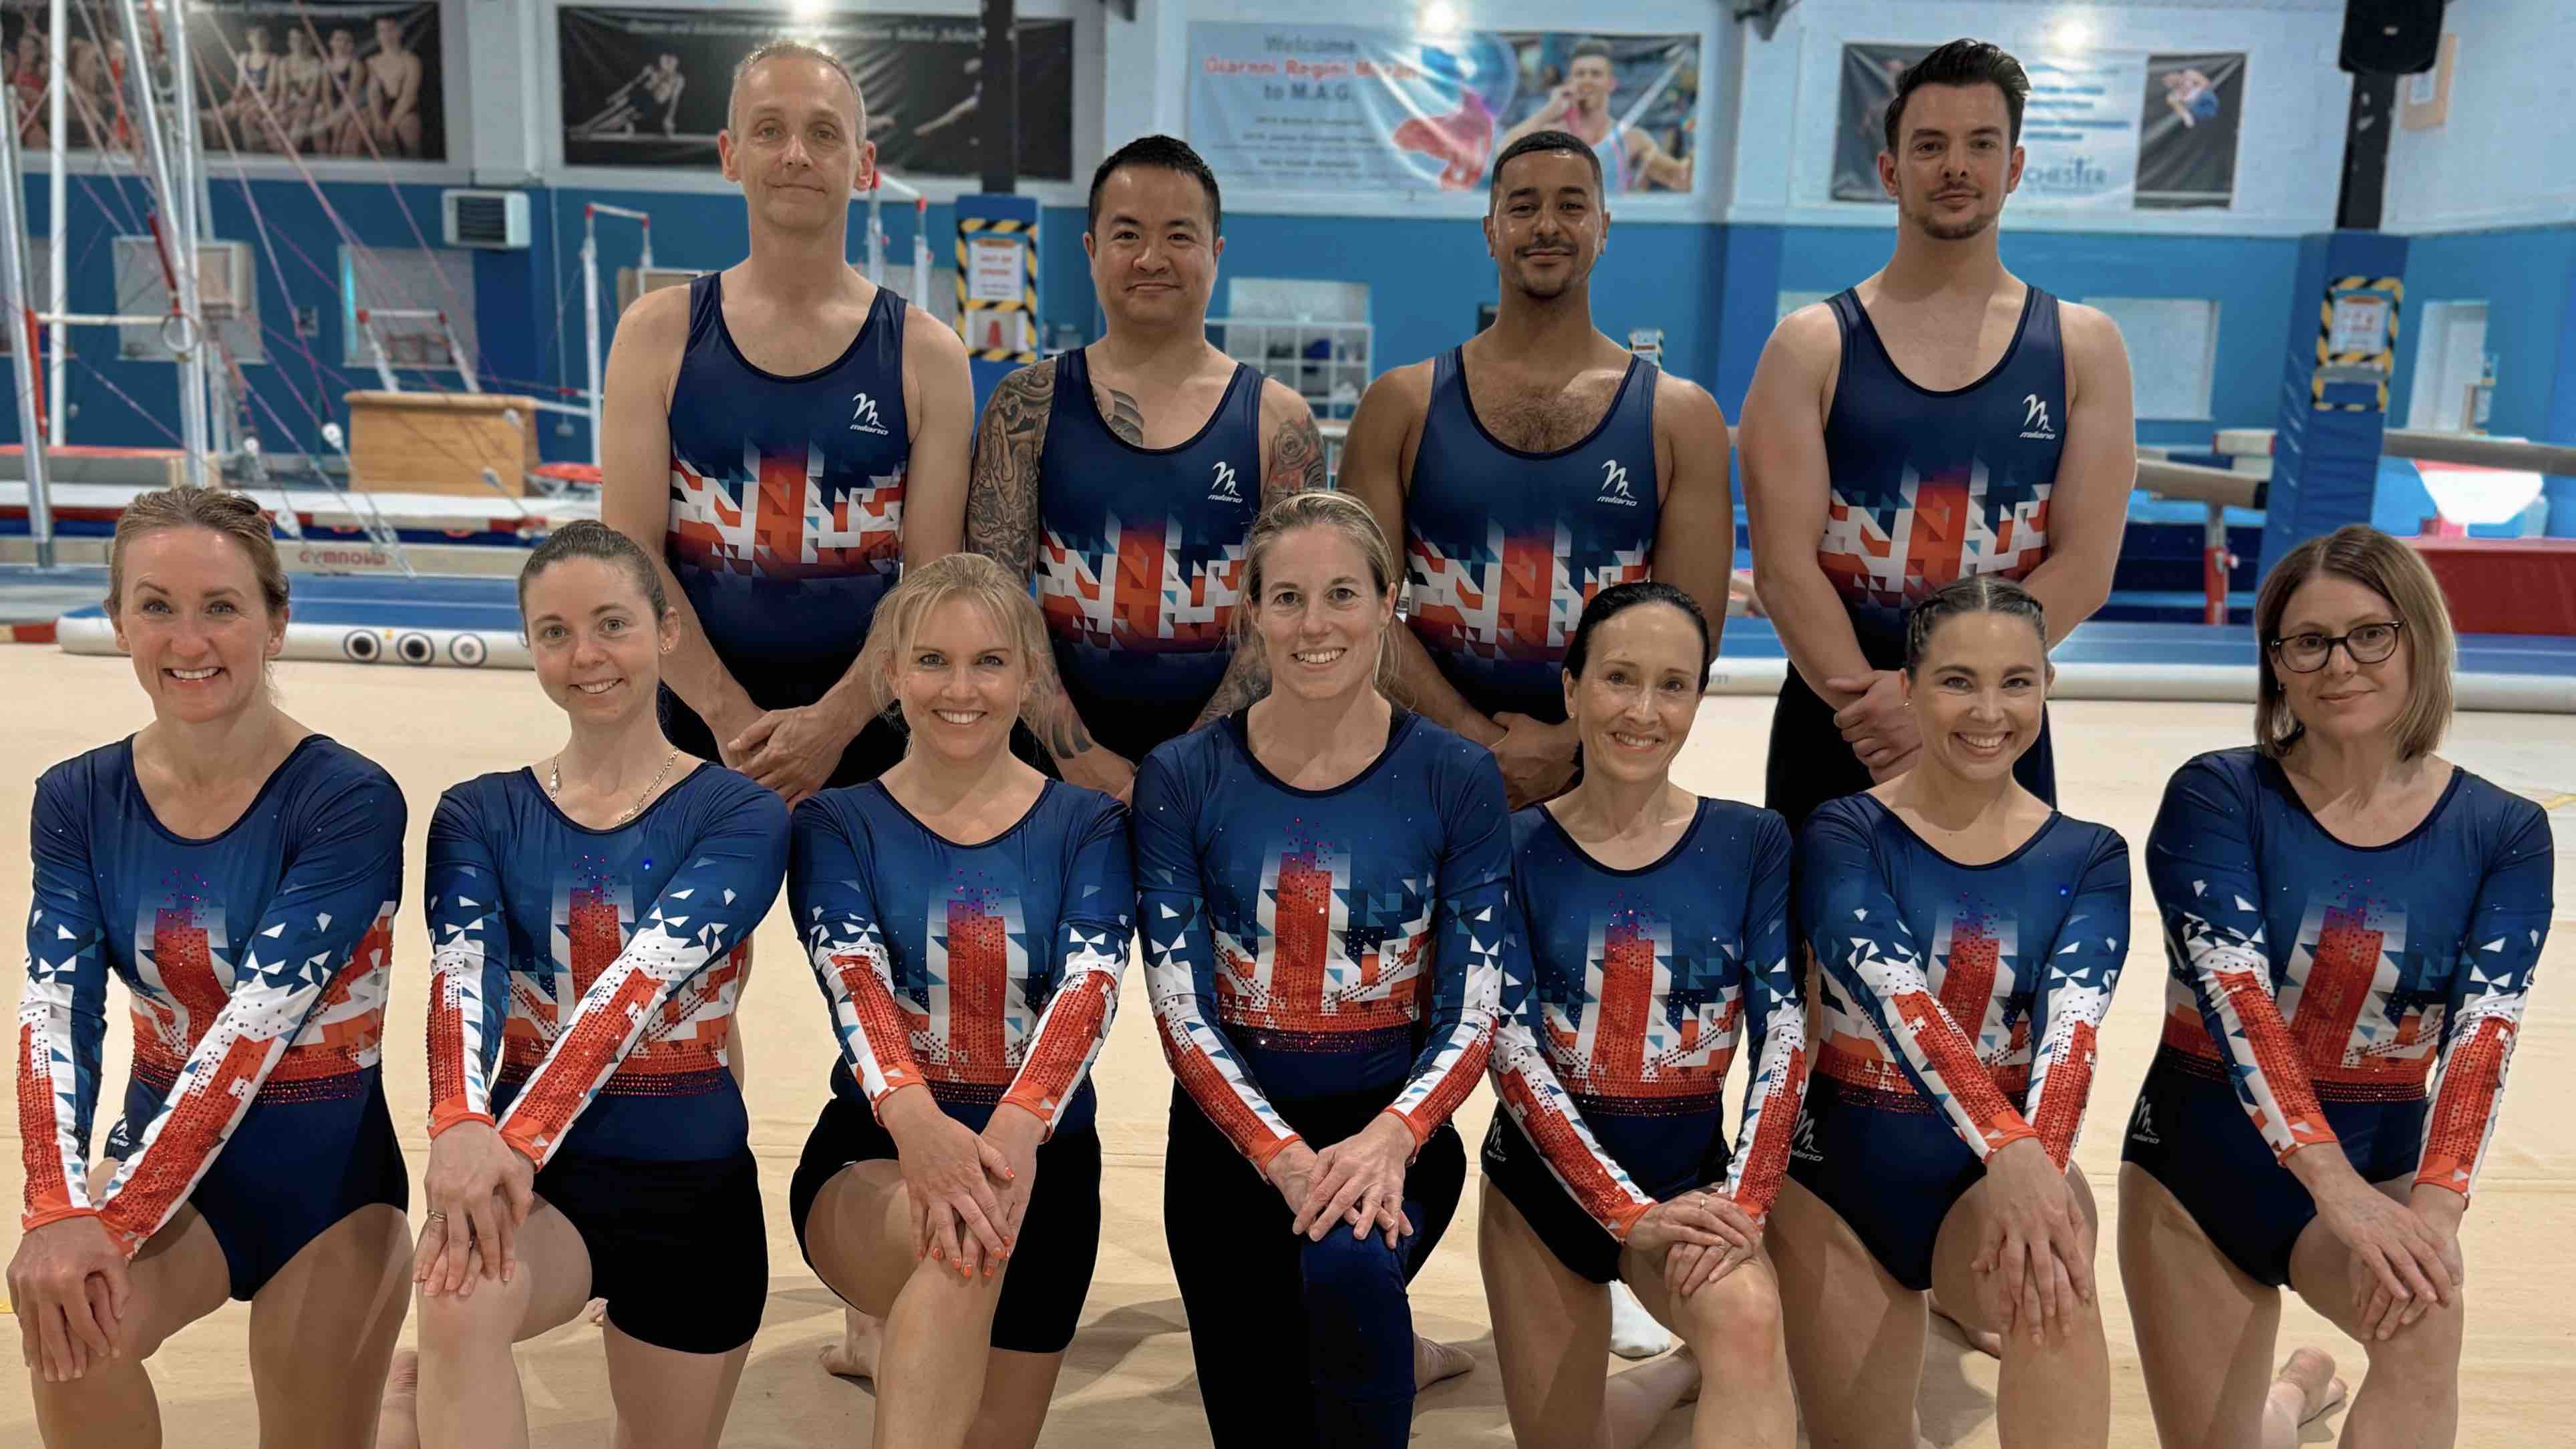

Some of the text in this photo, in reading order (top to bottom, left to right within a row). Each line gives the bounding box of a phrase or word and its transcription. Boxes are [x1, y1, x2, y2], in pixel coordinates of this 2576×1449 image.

[1265, 35, 1356, 53] Welcome
[1265, 85, 1284, 100] to
[1597, 496, 1638, 506] milano
